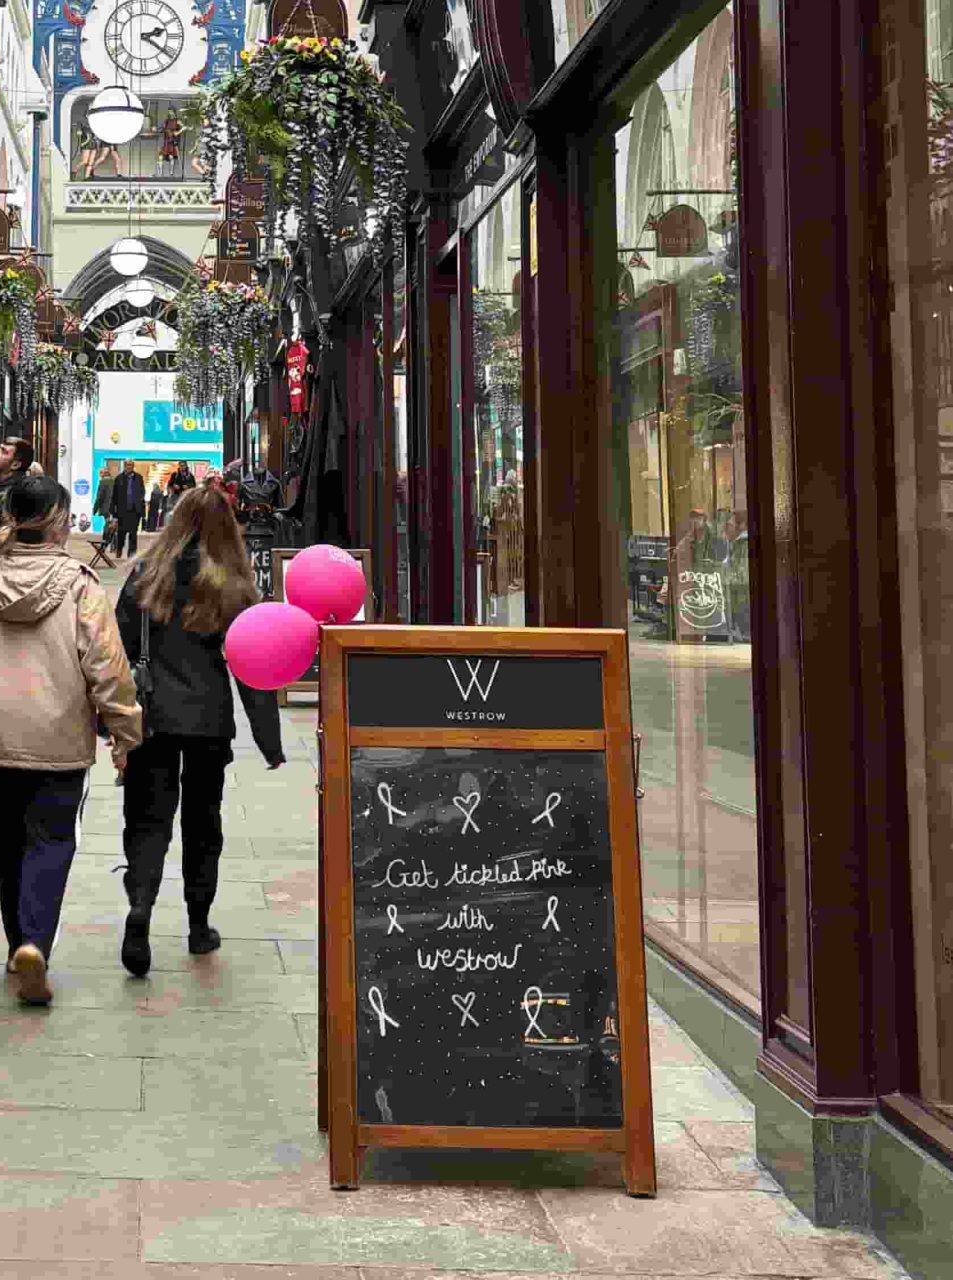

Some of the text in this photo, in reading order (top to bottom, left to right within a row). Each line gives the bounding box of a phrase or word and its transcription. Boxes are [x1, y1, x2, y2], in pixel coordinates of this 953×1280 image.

[446, 658, 500, 702] W
[445, 711, 506, 721] WESTROW
[371, 858, 439, 888] Get
[443, 859, 523, 887] tickled
[437, 903, 494, 931] with
